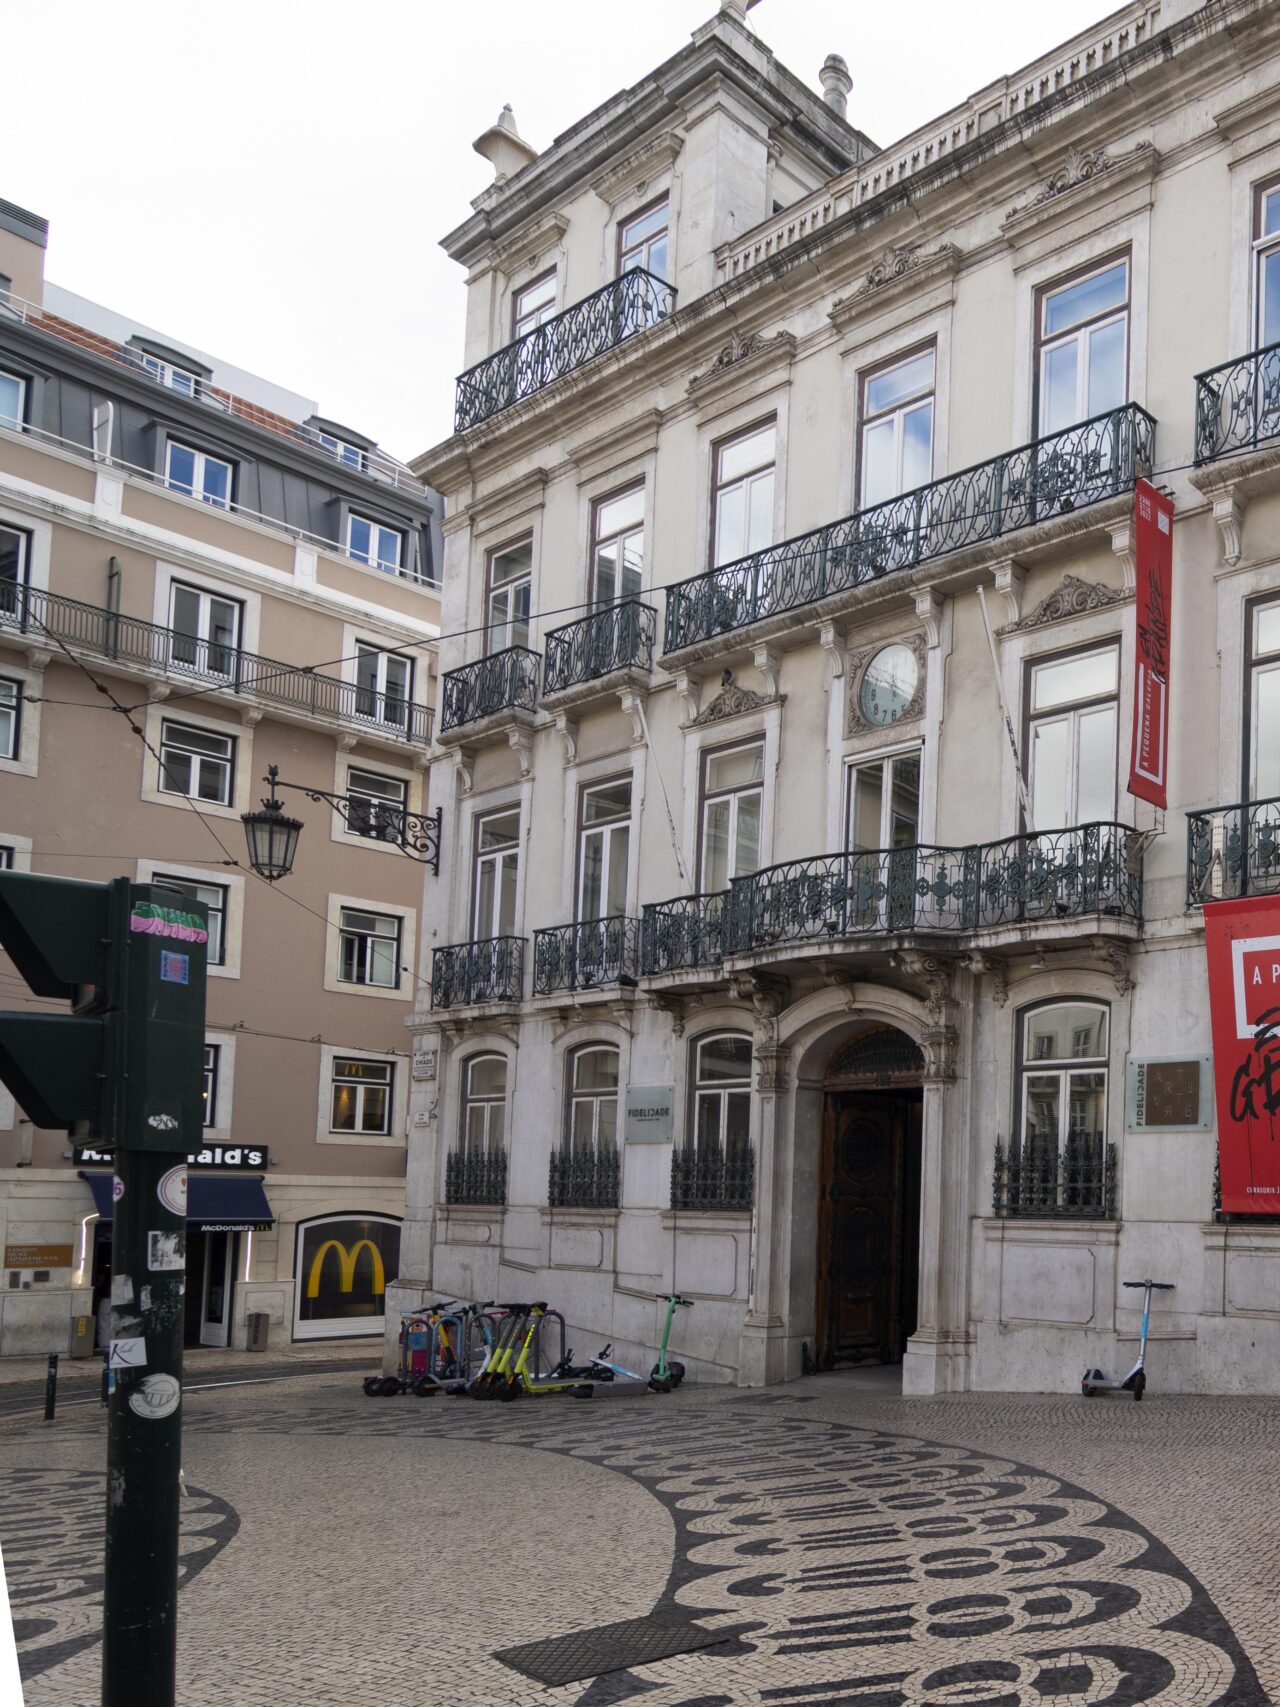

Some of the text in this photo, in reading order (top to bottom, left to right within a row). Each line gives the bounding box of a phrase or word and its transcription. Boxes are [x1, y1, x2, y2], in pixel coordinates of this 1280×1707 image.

[1142, 714, 1151, 758] PEQUENA
[1253, 966, 1262, 985] A
[1136, 1063, 1145, 1127] FIDELIDADE
[628, 1108, 670, 1118] FIDELIDADE
[201, 1224, 255, 1232] McDonald's
